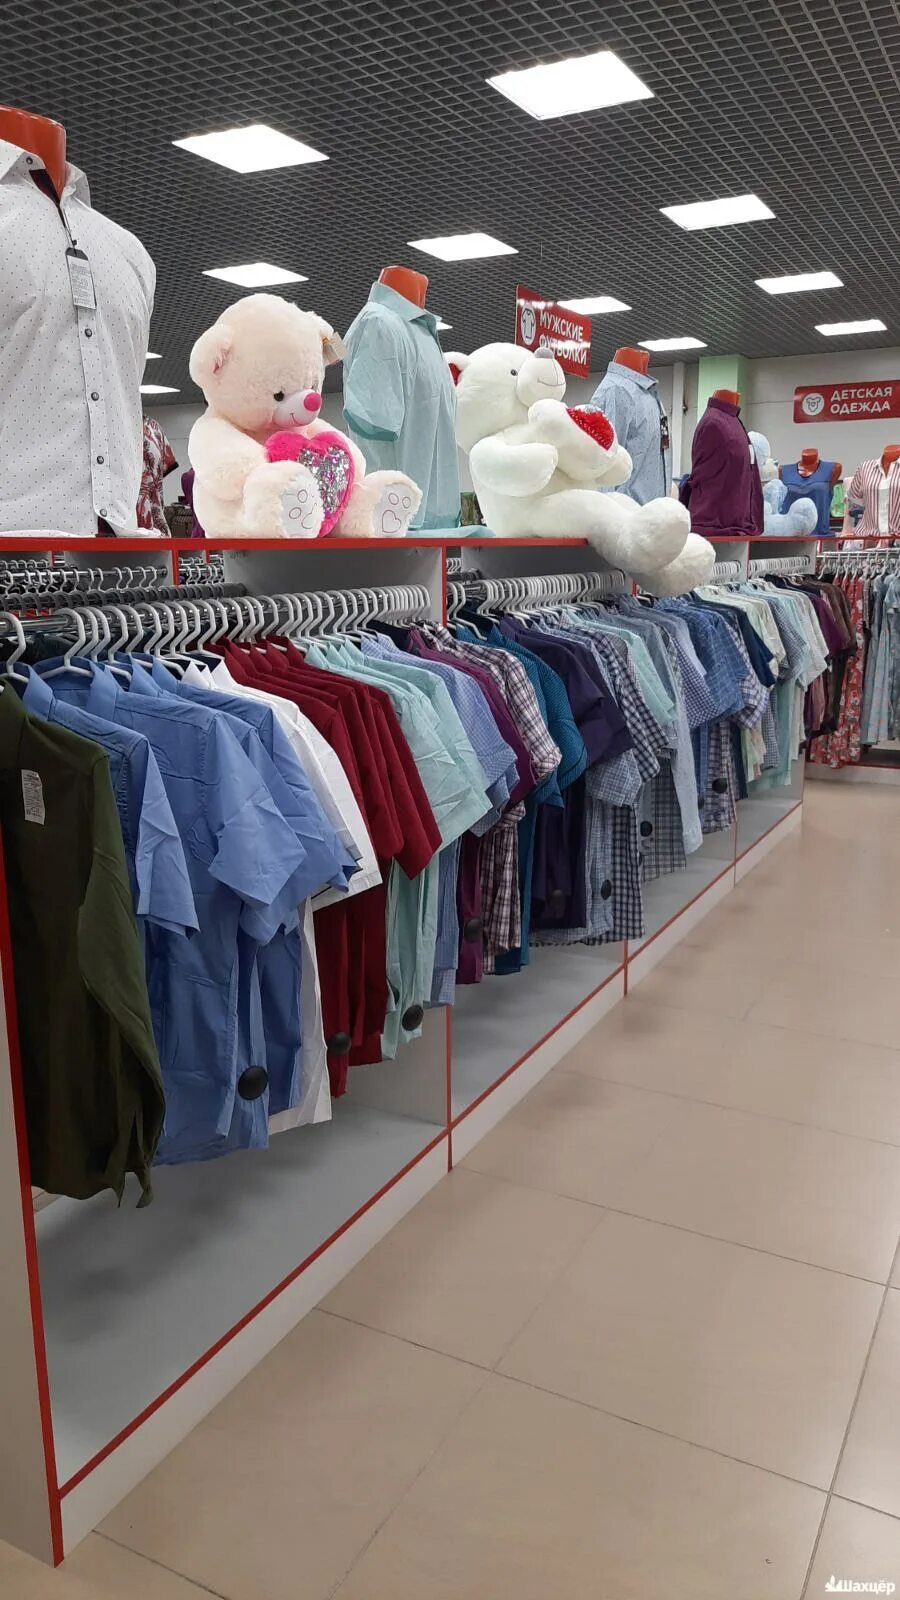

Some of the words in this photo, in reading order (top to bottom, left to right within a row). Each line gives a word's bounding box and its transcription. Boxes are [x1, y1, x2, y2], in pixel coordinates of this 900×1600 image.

[540, 310, 584, 342] МУЖСКИЕ
[831, 387, 893, 402] ДЕТСКАЯ
[830, 400, 891, 415] ОДЕЖДА
